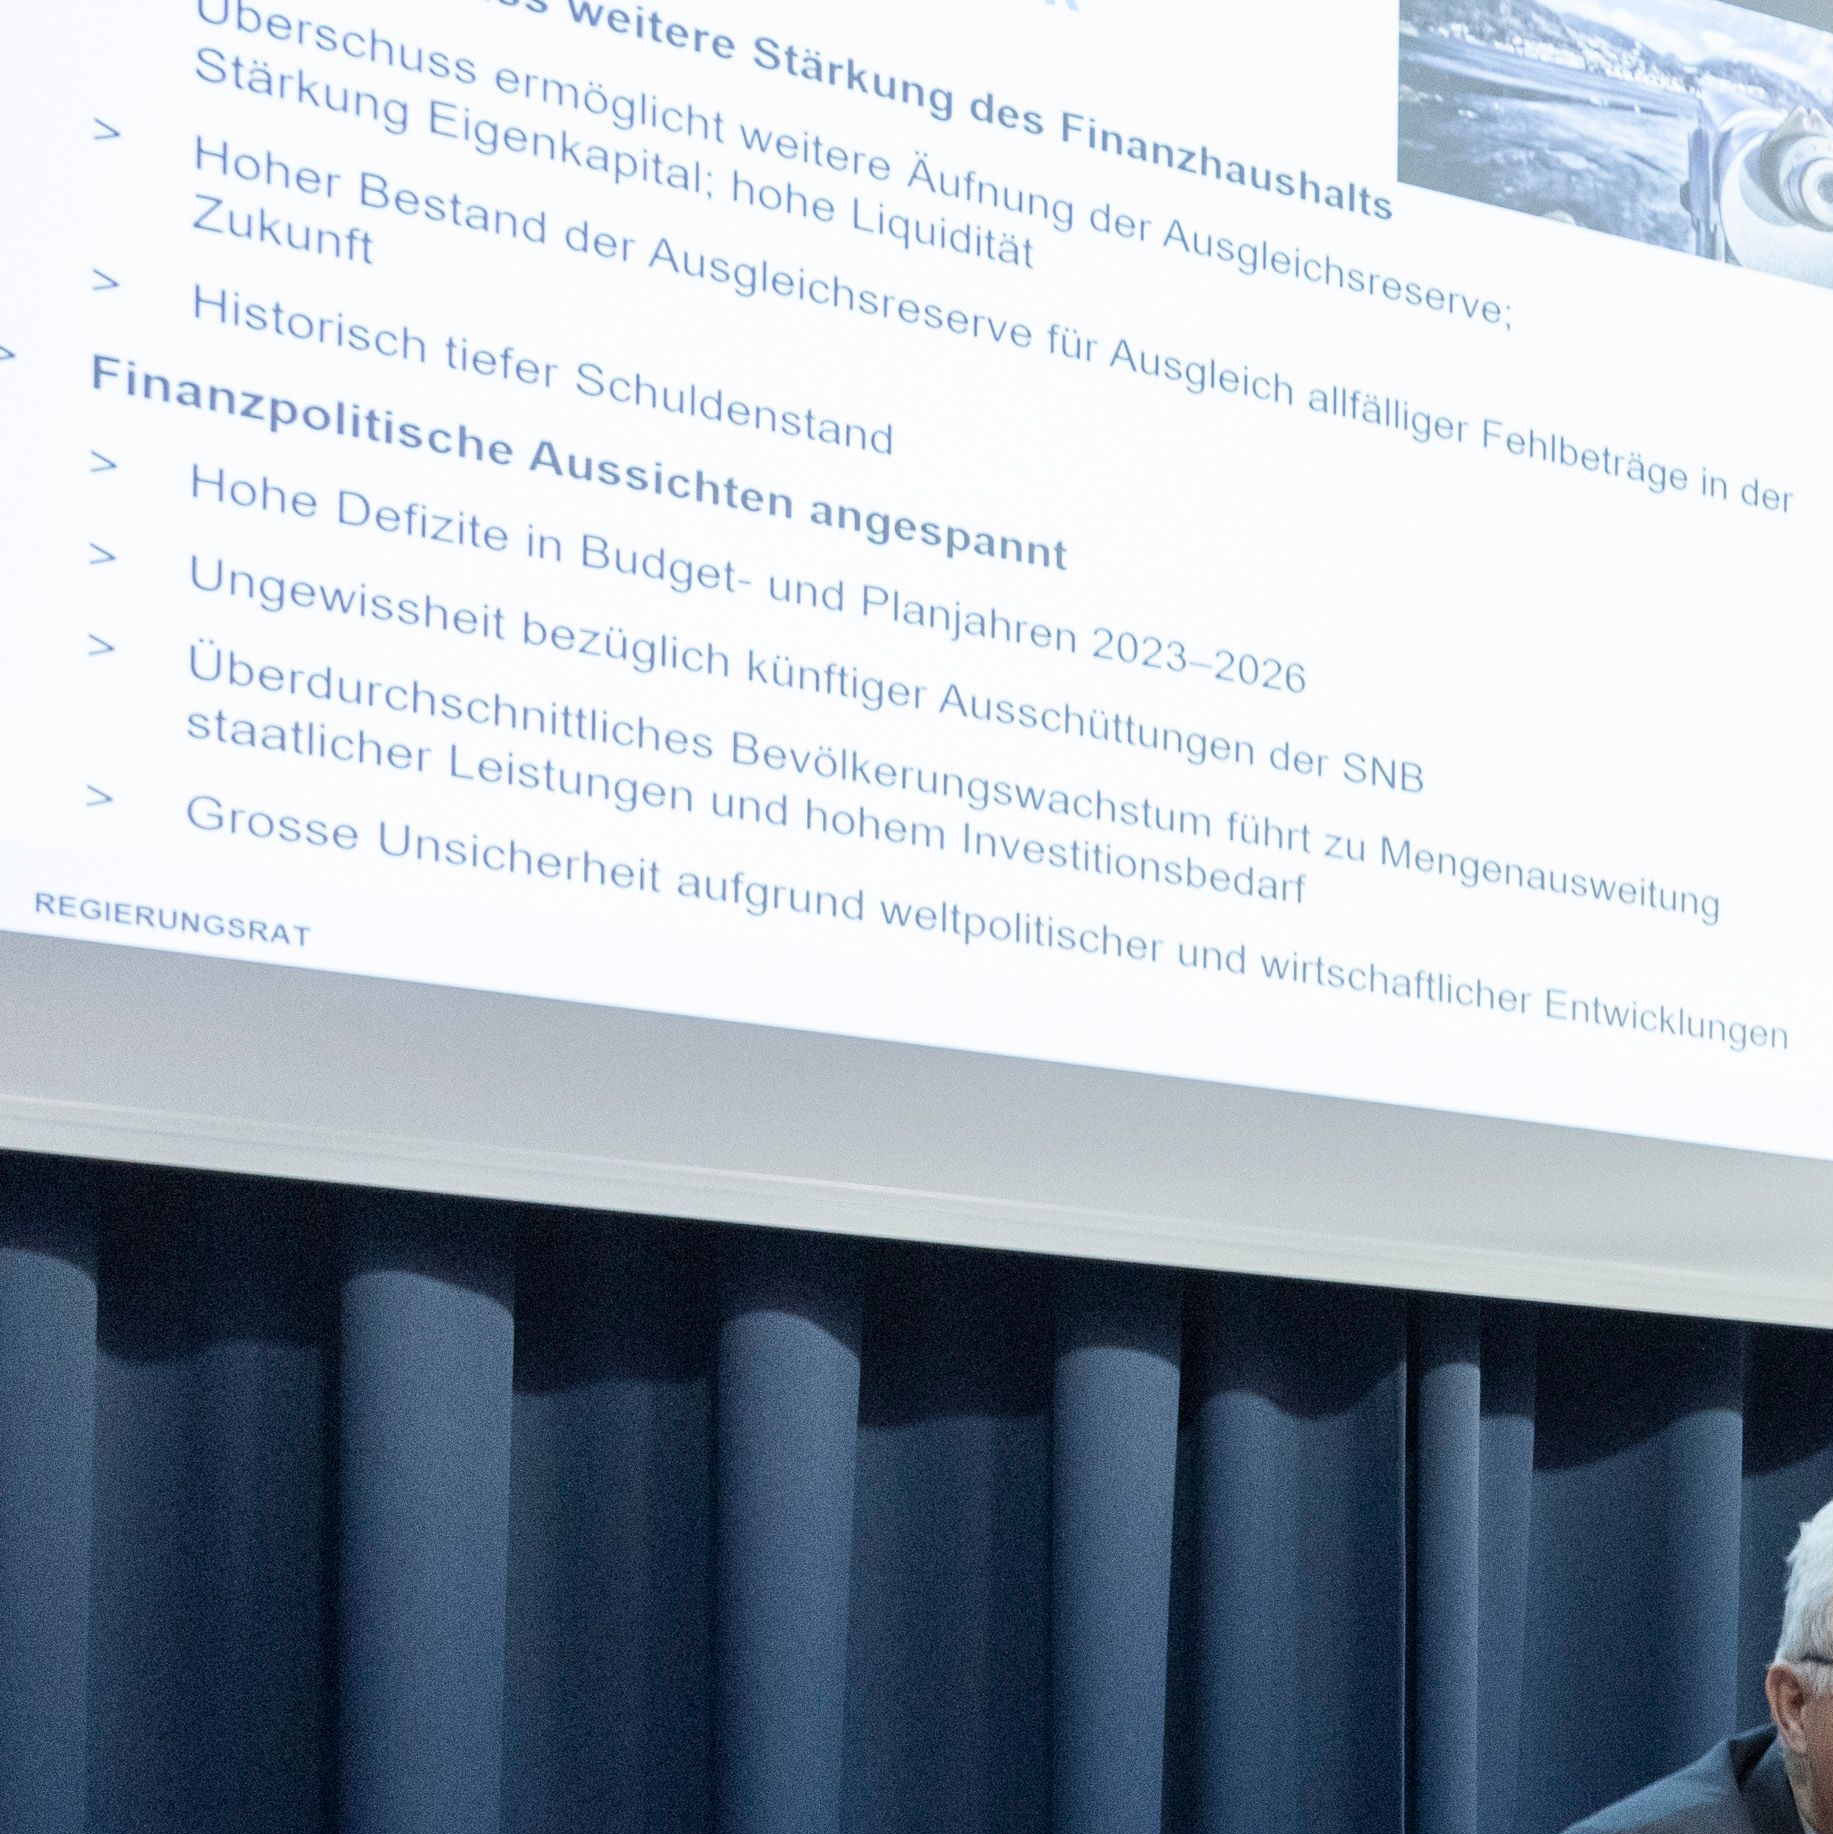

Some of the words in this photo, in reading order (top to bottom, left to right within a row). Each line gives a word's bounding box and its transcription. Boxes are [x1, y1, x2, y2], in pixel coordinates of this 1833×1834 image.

[194, 45, 409, 136] Stärkung
[428, 97, 713, 201] Eigenkapital;
[732, 168, 836, 223] hohe
[852, 195, 1034, 270] Liquidität
[494, 66, 725, 145] ermöglicht
[738, 122, 892, 182] weitere
[906, 149, 1074, 234] Äufnung
[1088, 201, 1152, 242] der
[1162, 217, 1512, 331] Ausgleichsreserve;
[566, 0, 737, 61] weitere
[752, 34, 954, 123] Stärkung
[968, 90, 1045, 136] des
[1061, 109, 1394, 222] Finanzhaushalts
[191, 191, 374, 266] Zukunft
[194, 133, 342, 199] Hoher
[359, 169, 547, 245] Bestand
[564, 218, 636, 263] der
[647, 235, 1033, 349] Ausgleichsreserve
[1046, 322, 1099, 363] für
[1108, 336, 1294, 407] Ausgleich
[1307, 383, 1469, 444] allfälliger
[1482, 416, 1689, 495] Fehlbeträge
[1701, 465, 1728, 501] in
[1739, 477, 1794, 514] der
[91, 351, 514, 467] Finanzpolitische
[528, 437, 794, 521] Aussichten
[809, 499, 1068, 572] angespannt
[193, 281, 427, 364] Historisch
[444, 335, 559, 389] tiefer
[575, 360, 894, 456] Schuldenstand
[191, 461, 318, 519] Hohe
[337, 487, 509, 553] Defizite
[527, 522, 563, 562] in
[581, 531, 752, 595] Budget-
[768, 574, 845, 613] und
[862, 582, 1077, 654] Planjahren
[189, 636, 714, 760] Überdurchschnittliches
[731, 729, 1212, 838] Bevölkerungswachstum
[1226, 809, 1311, 854] führt
[1323, 832, 1366, 863] zu
[1380, 834, 1720, 927] Mengenausweitung
[190, 553, 506, 641] Ungewissheit
[522, 609, 730, 678] bezüglich
[747, 647, 928, 713] künftiger
[938, 681, 1255, 767] Ausschüttungen
[1268, 740, 1329, 777] der
[1342, 750, 1425, 794] SNB
[186, 707, 432, 773] staatlicher
[449, 741, 694, 814] Leistungen
[711, 790, 788, 827] und
[805, 796, 946, 850] hohem
[963, 821, 1307, 904] Investitionsbedarf
[34, 889, 312, 947] REGIERUNGSRAT
[185, 793, 359, 851] Grosse
[378, 819, 661, 894] Unsicherheit
[676, 870, 865, 922] aufgrund
[879, 898, 1164, 963] weltpolitischer
[1177, 941, 1246, 975] und
[1260, 950, 1532, 1015] wirtschaftlicher
[1545, 986, 1789, 1052] Entwicklungen
